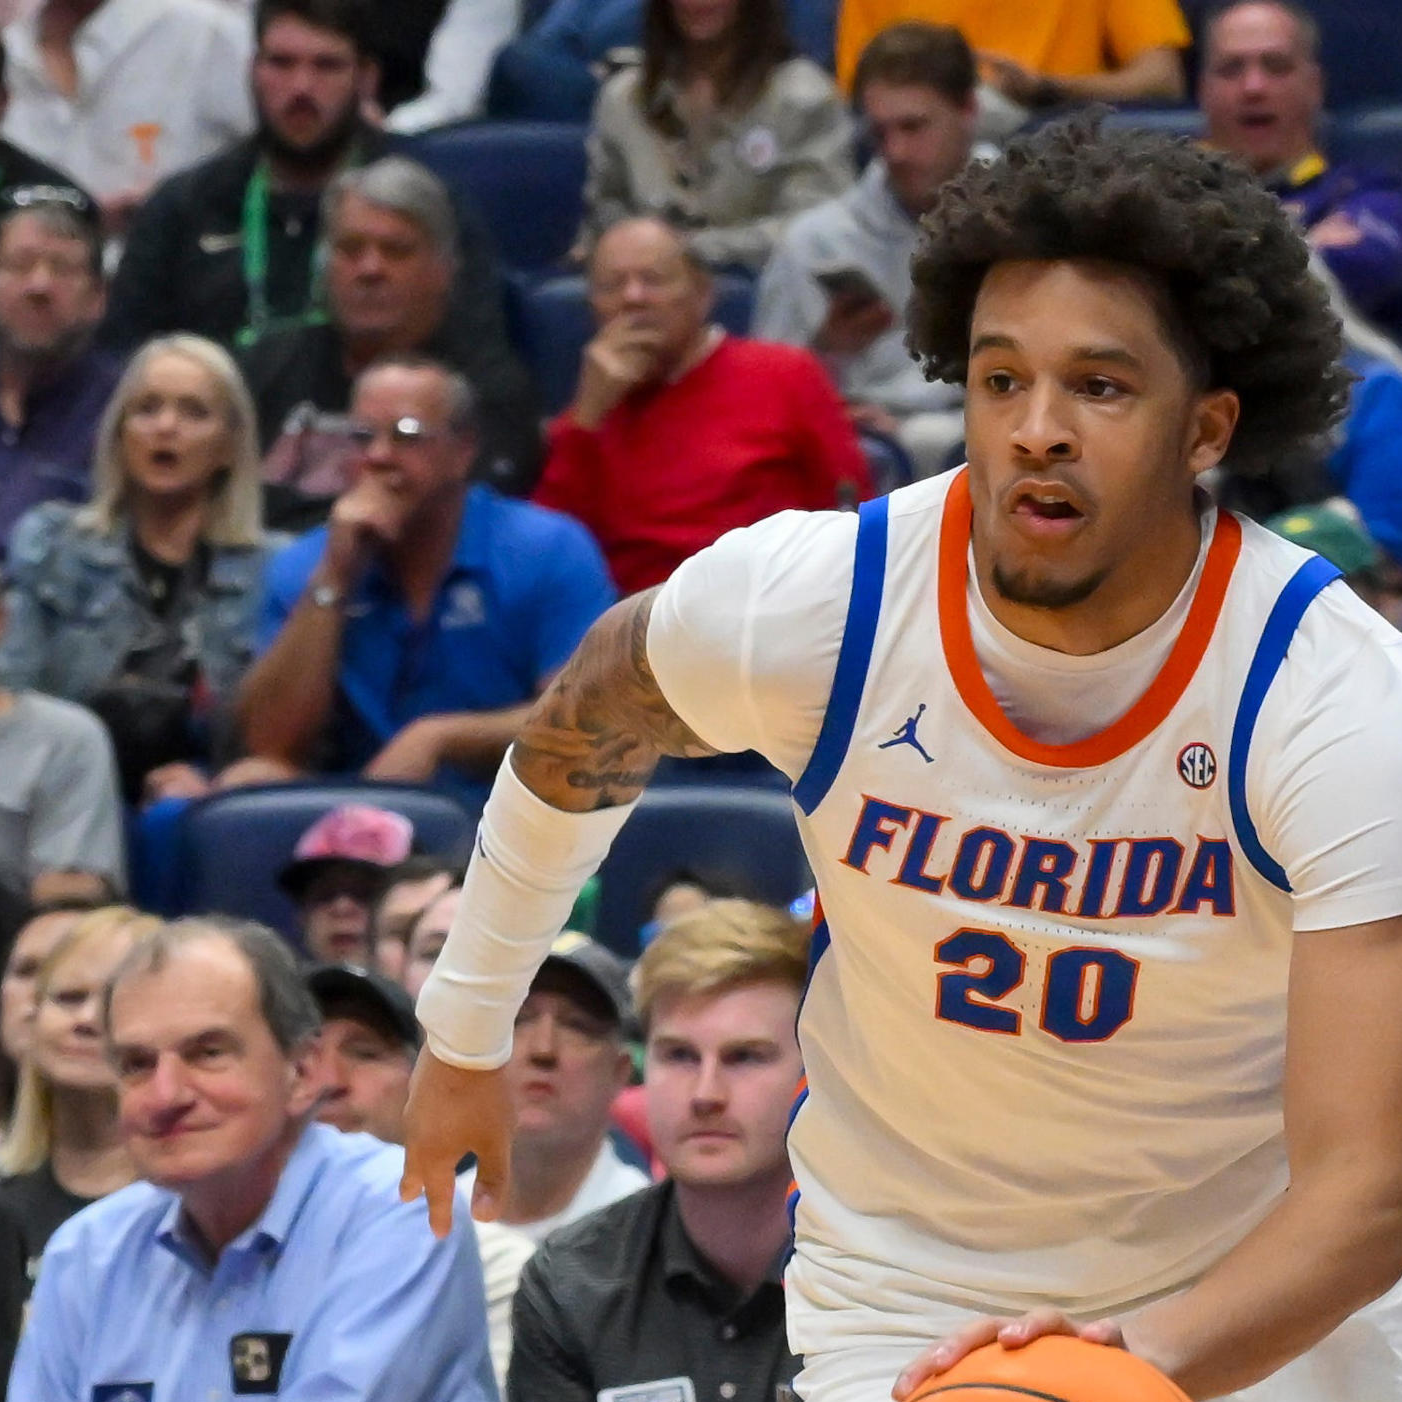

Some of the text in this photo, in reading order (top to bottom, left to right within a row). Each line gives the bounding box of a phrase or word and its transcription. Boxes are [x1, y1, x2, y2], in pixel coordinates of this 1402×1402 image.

[1181, 746, 1215, 786] SEC
[838, 793, 1237, 919] FLORIDA
[933, 926, 1141, 1043] 20
